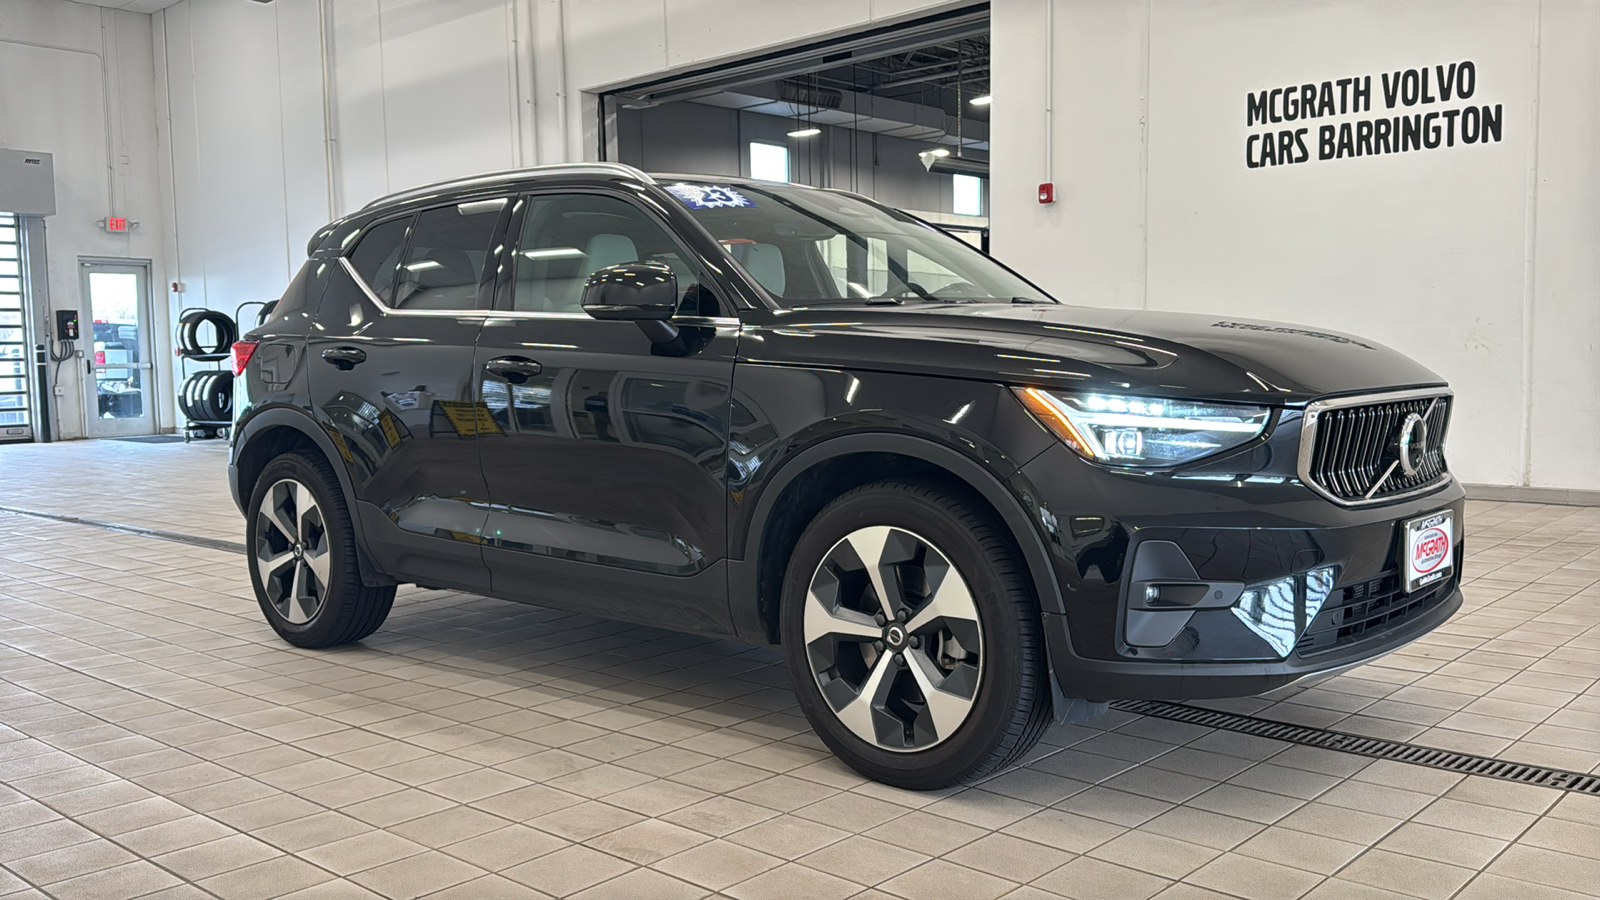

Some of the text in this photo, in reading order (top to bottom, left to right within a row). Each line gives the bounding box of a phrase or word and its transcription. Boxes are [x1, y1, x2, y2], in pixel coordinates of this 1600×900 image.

[1247, 61, 1476, 127] MCGRATH VOLVO
[1246, 104, 1503, 169] CARS BARRINGTON
[109, 217, 126, 231] EXIT
